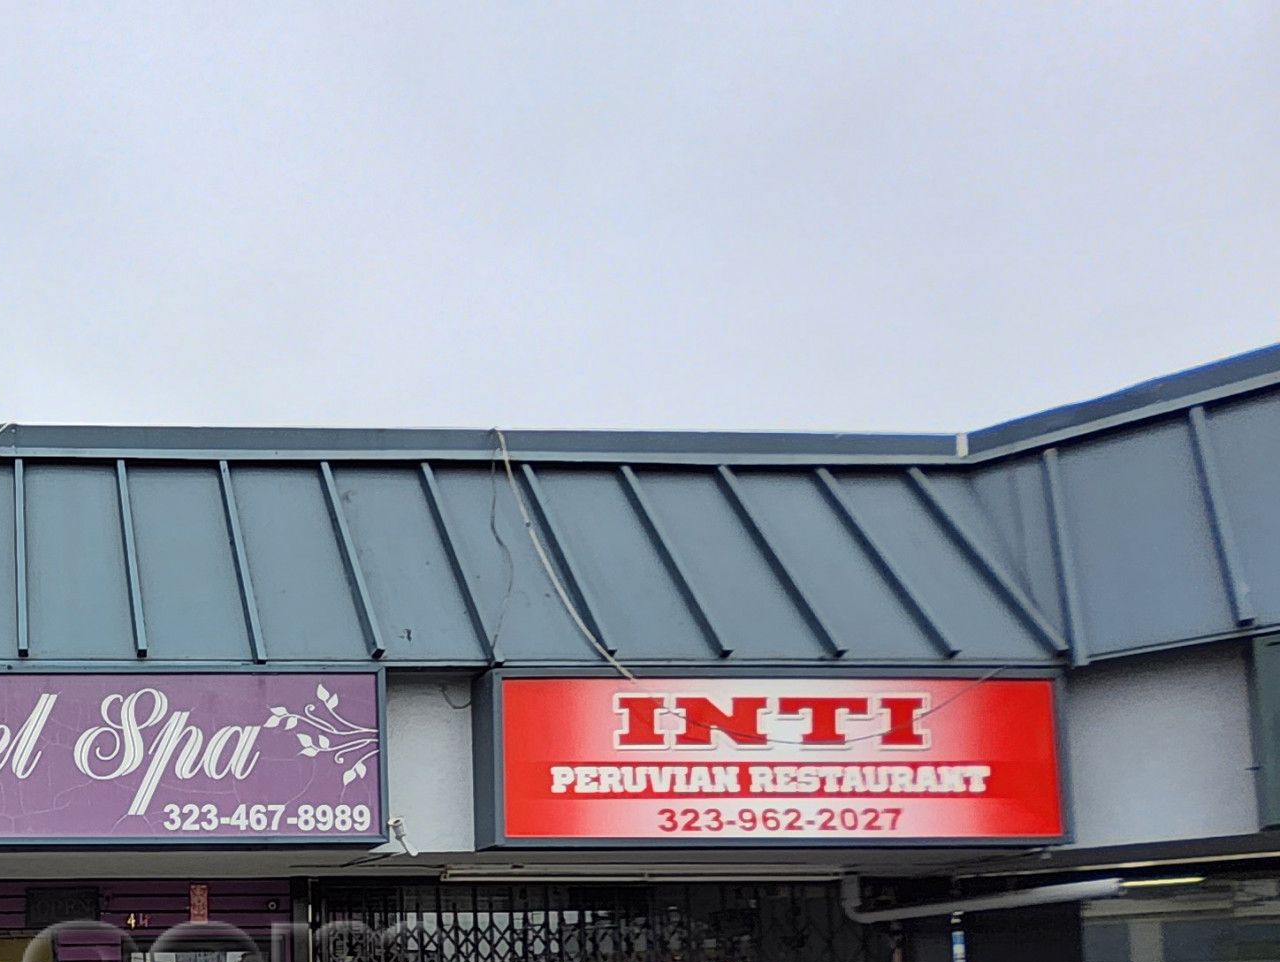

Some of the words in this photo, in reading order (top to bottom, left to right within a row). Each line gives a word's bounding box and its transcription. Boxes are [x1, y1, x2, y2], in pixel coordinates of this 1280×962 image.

[611, 691, 931, 751] INTI
[73, 687, 264, 817] Spa
[550, 764, 739, 794] PERUVIAN
[749, 764, 991, 794] RESTAURANT
[163, 804, 372, 832] 323-467-8989
[657, 807, 904, 832] 323-962-2027
